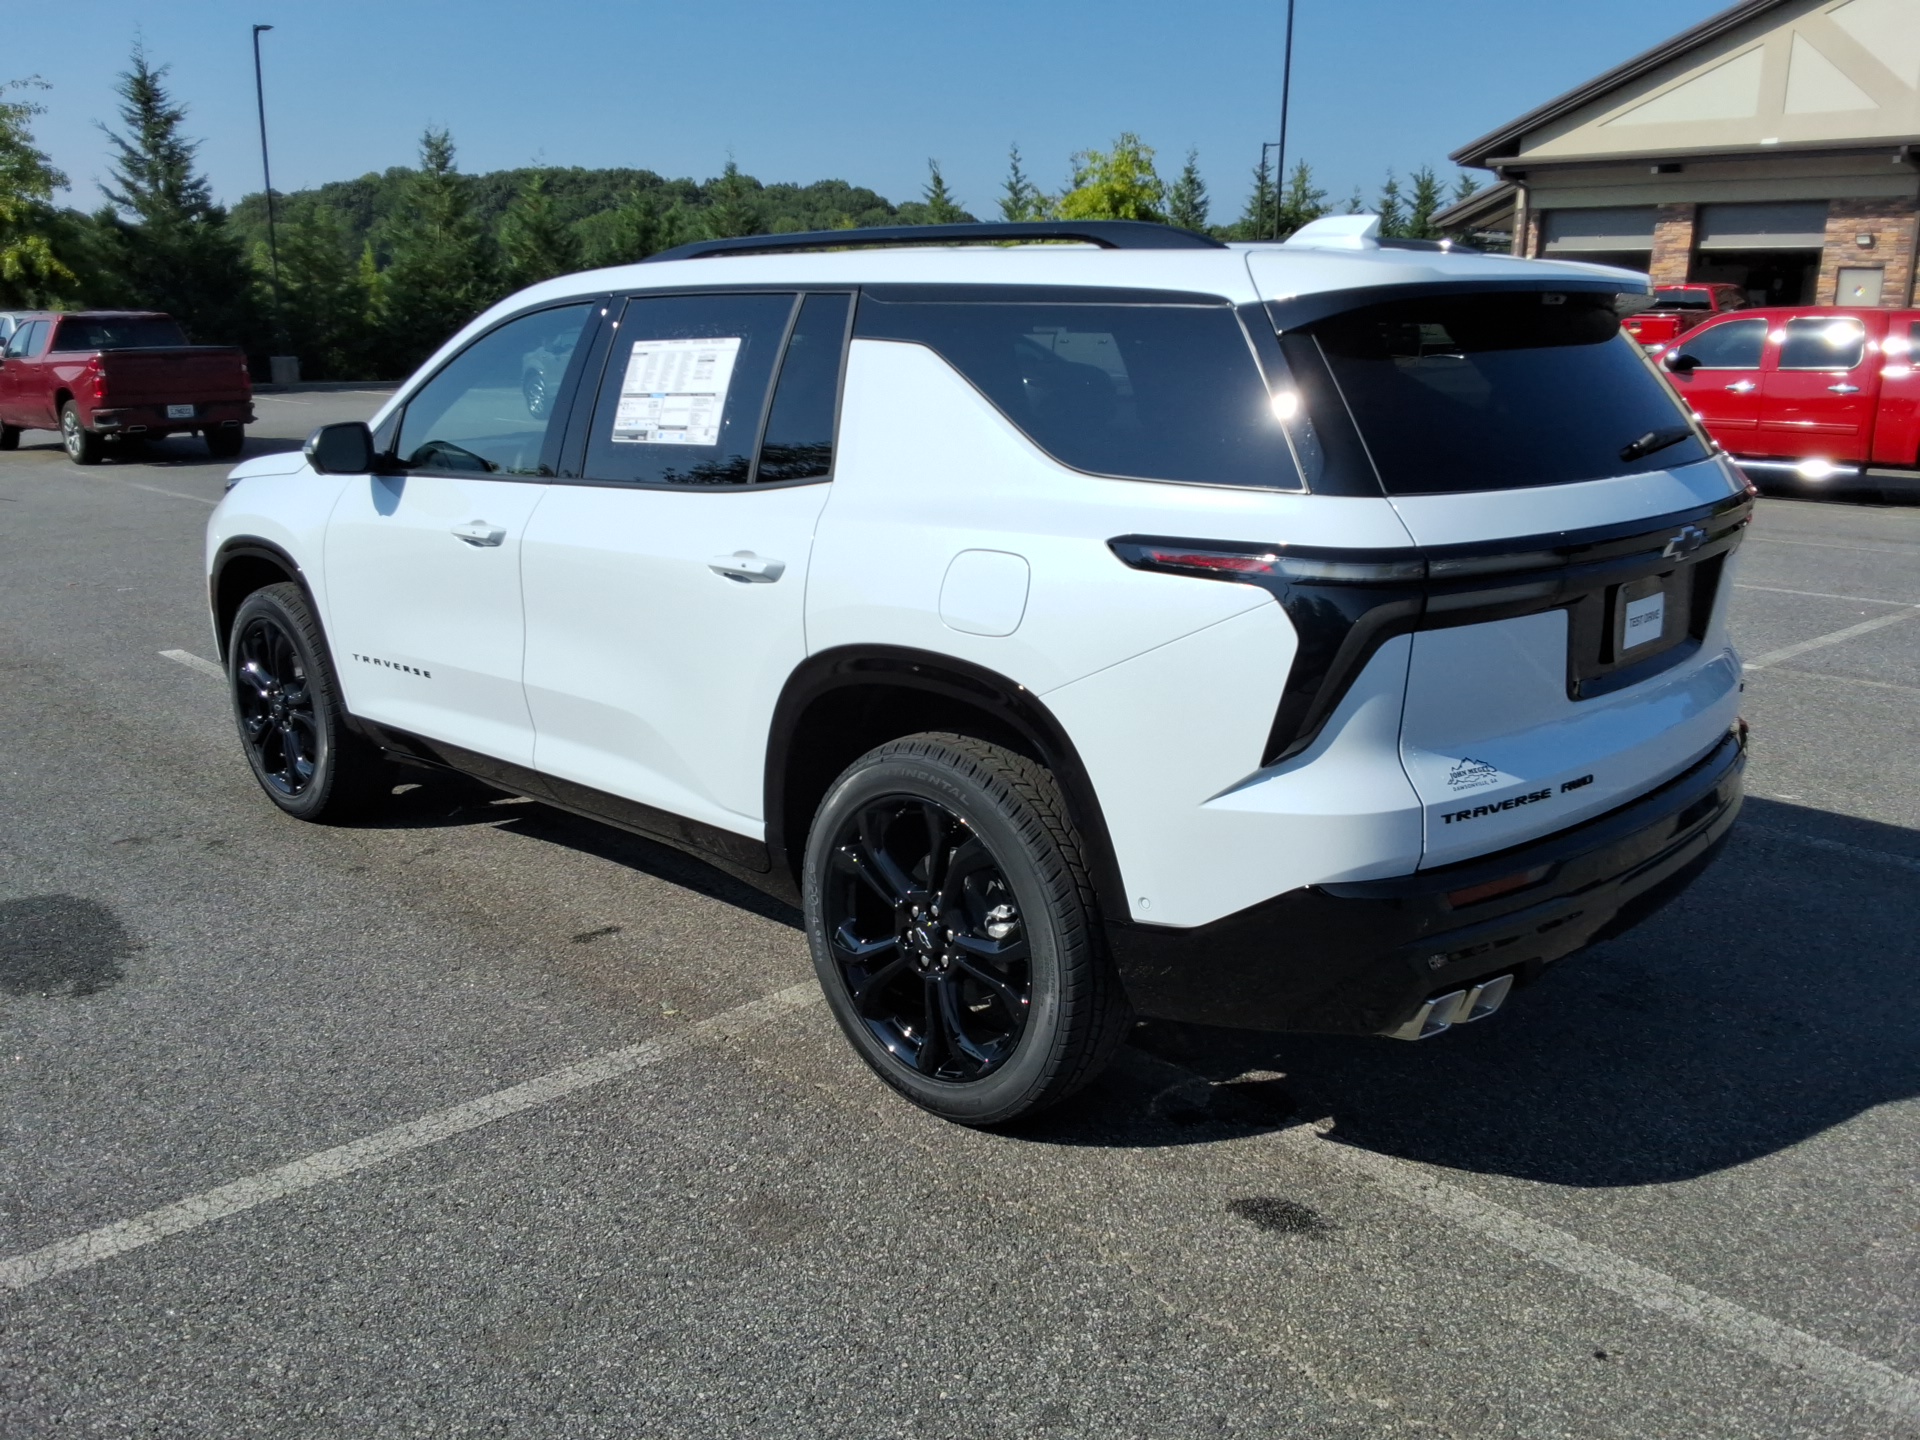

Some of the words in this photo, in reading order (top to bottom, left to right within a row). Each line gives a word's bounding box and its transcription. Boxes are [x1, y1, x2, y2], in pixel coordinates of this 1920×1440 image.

[1629, 614, 1643, 628] TEST
[1644, 608, 1660, 624] DRIVE
[352, 653, 432, 679] TRAVERSE
[872, 767, 970, 806] NTINENTAL
[1450, 770, 1467, 781] JOHN
[1441, 788, 1552, 824] TRAVERSE
[1561, 774, 1594, 794] AWD
